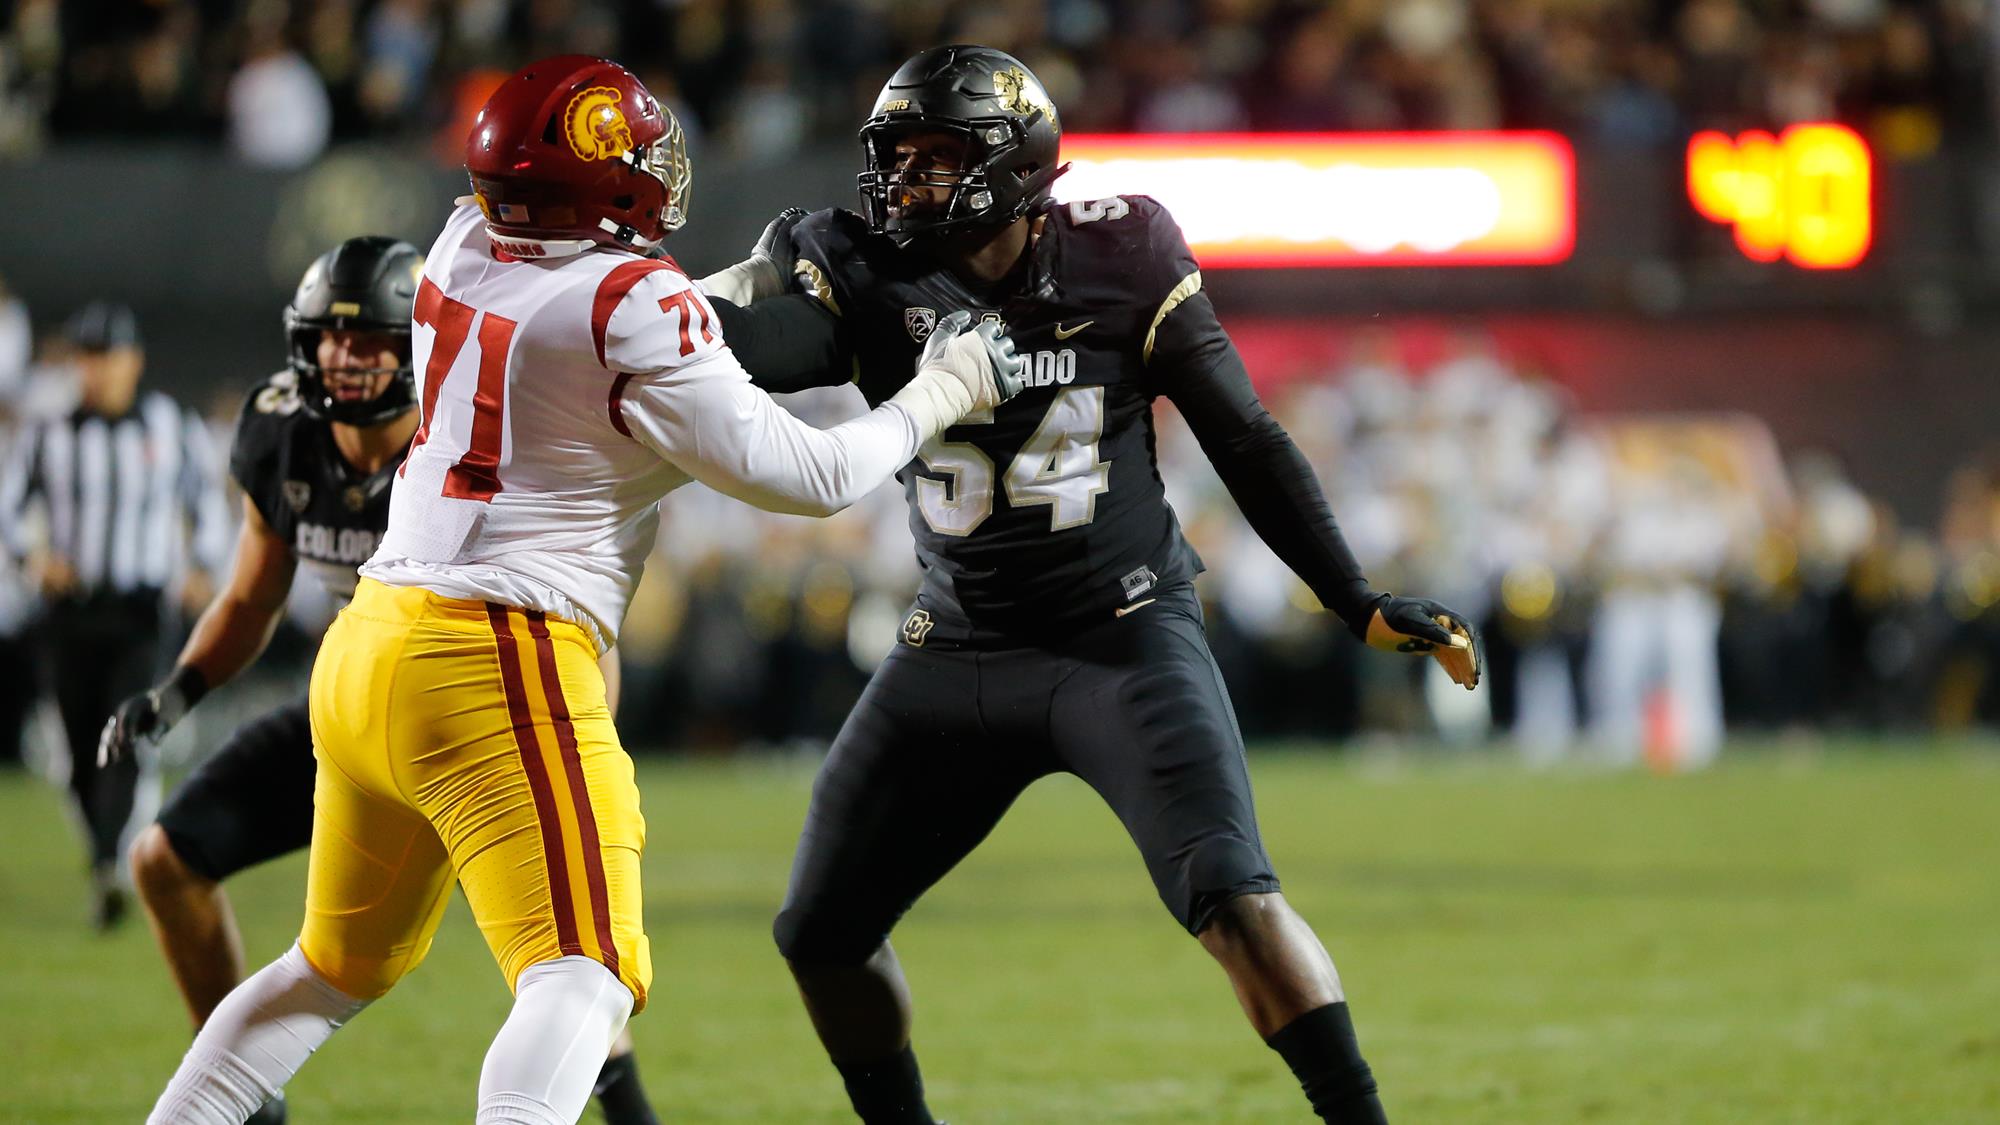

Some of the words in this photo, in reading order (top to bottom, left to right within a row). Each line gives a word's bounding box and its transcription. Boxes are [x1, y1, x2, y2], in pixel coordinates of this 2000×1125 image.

[656, 287, 714, 358] 71
[912, 322, 928, 336] 12
[397, 273, 519, 505] 71
[915, 384, 1113, 538] 54
[296, 521, 382, 564] COLOR
[1129, 575, 1142, 587] 46
